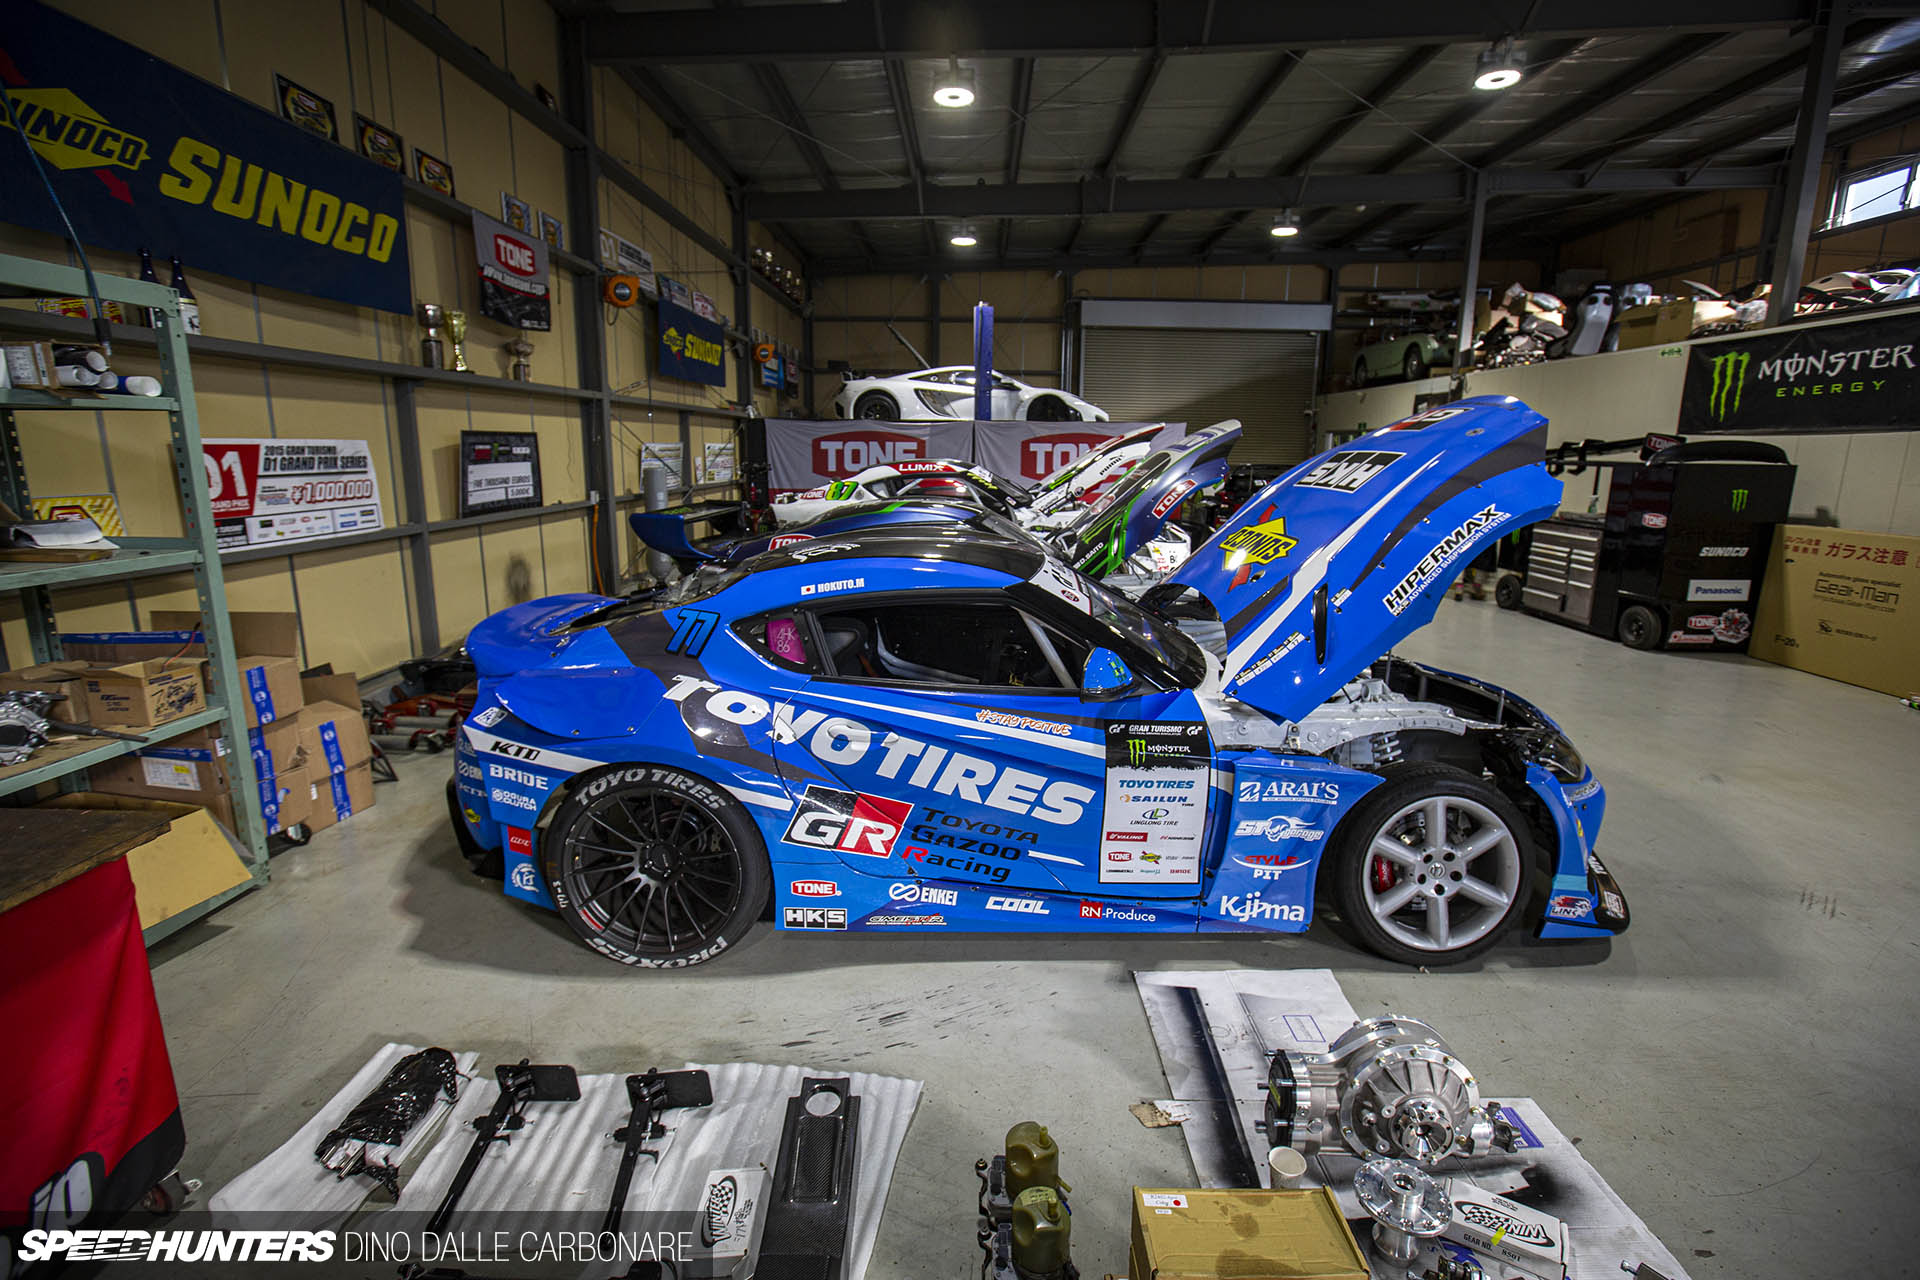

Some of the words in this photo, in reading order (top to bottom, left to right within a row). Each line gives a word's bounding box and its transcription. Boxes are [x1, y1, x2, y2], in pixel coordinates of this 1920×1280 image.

[0, 97, 143, 166] UNOCO
[159, 137, 399, 263] SUNOCO
[496, 237, 535, 273] TONE
[1757, 344, 1916, 382] MONSTER
[1775, 380, 1886, 398] ENERGY
[279, 457, 314, 471] GRAND
[317, 456, 338, 470] PRIX
[340, 456, 367, 469] SERIES
[898, 463, 944, 472] LUMIX
[1301, 462, 1385, 488] HKS
[825, 481, 859, 500] 87
[1157, 480, 1194, 514] TONE
[1223, 529, 1293, 561] SUNOCO
[1410, 567, 1443, 602] ADVANCED
[1484, 511, 1512, 533] SYSTEM
[1700, 546, 1750, 558] SUNOCO
[1825, 542, 1910, 566] ガラス注意
[1383, 504, 1503, 611] HIPERMAX
[817, 578, 865, 593] HOKUTO.M
[1695, 586, 1743, 595] Panasonic
[1814, 578, 1900, 605] Gear-Man
[976, 709, 1020, 728] #STAY
[1020, 717, 1072, 736] POSITIVE
[1128, 724, 1150, 732] GRAN
[1151, 725, 1183, 733] TURISMO
[663, 674, 872, 765] TOYO
[879, 732, 1097, 825] TIRES
[1147, 744, 1191, 753] MONSTER
[489, 764, 549, 790] BRIDE
[575, 768, 646, 806] TOYO
[651, 769, 727, 810] TIRES
[1119, 780, 1155, 789] TOYO
[1156, 780, 1195, 789] TIRES
[503, 797, 537, 811] CLUTCH
[791, 811, 900, 853] GR
[921, 806, 1039, 845] TOYOTA
[910, 826, 1021, 862] GAZOO
[901, 846, 1012, 883] Racing
[1244, 855, 1299, 865] STYLE
[1253, 869, 1282, 880] PIT
[795, 883, 834, 894] TONE
[920, 887, 959, 906] ENKEI
[785, 909, 845, 923] HKS
[985, 896, 1050, 915] COOL
[1081, 906, 1156, 922] RN-Produce
[586, 936, 728, 968] PROXES
[1463, 1233, 1481, 1246] GEAR
[1481, 1239, 1493, 1251] NO.
